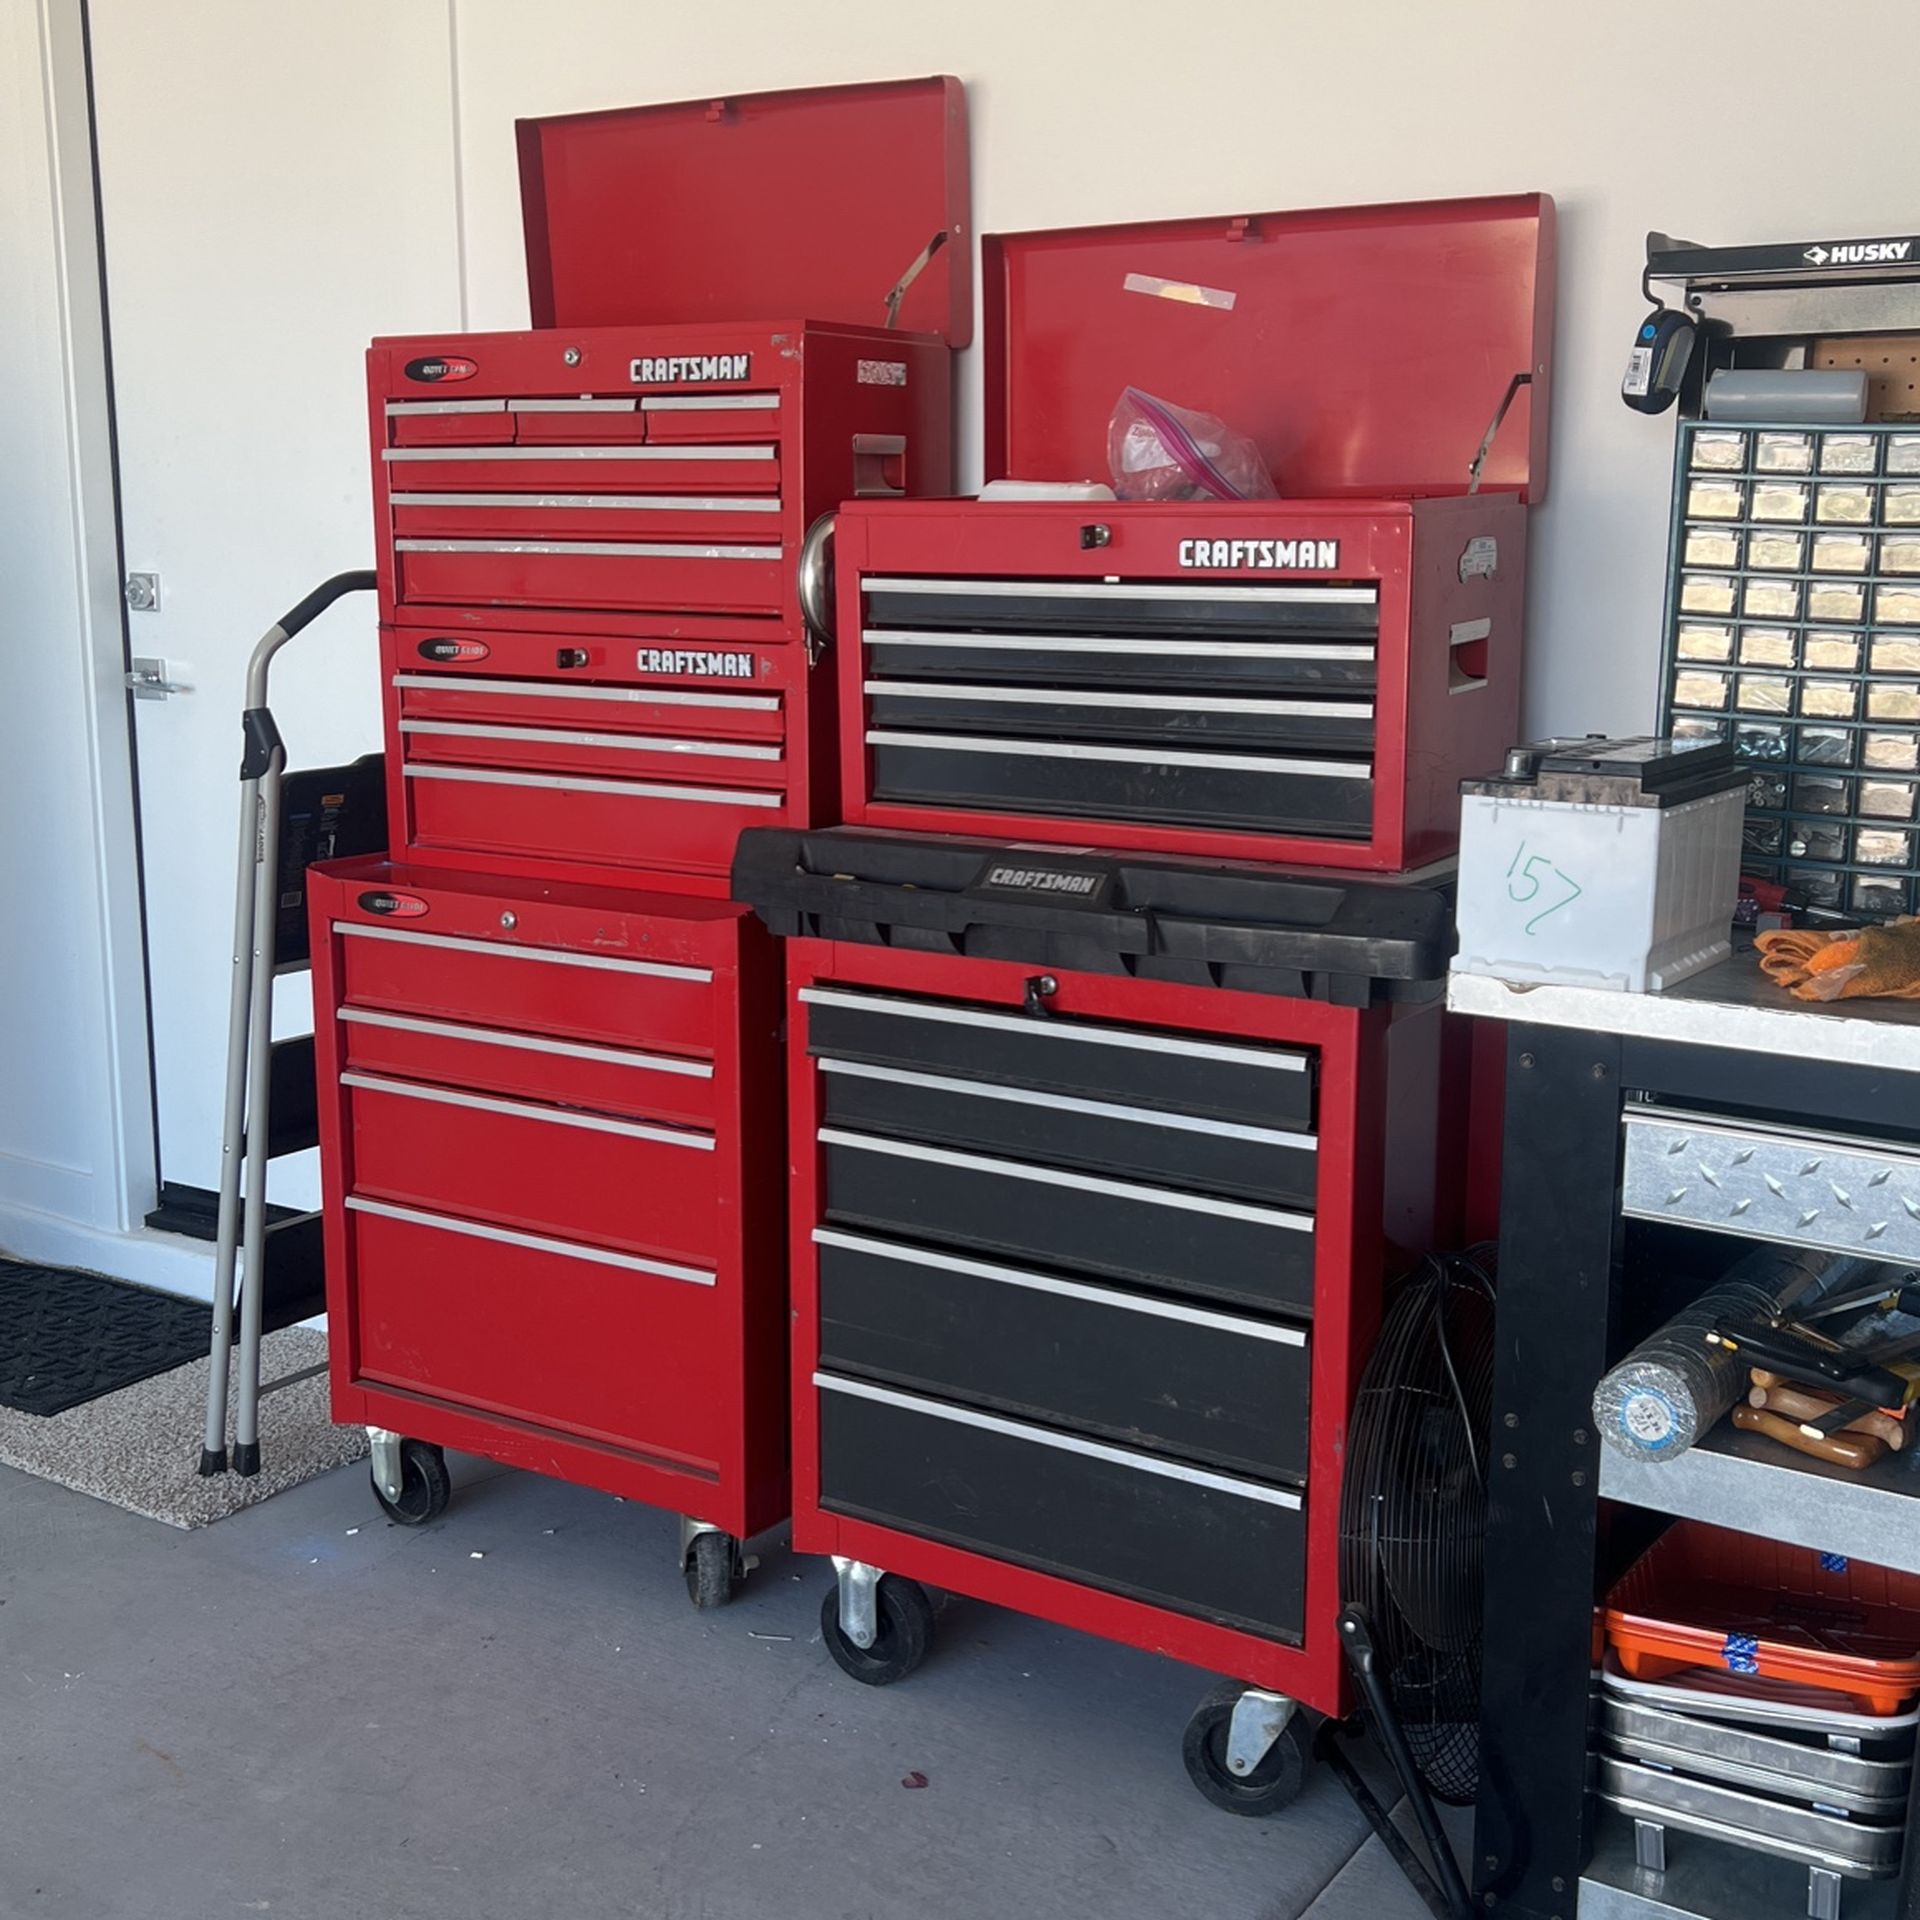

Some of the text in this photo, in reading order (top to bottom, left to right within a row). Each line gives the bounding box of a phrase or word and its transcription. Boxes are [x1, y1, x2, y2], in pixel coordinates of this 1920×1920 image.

[1831, 242, 1911, 263] HUSKY
[629, 355, 749, 382] CRAFTSMAN
[1179, 540, 1338, 569] CRAFTSMAN
[637, 649, 754, 677] CRAFTSMAN
[989, 867, 1096, 893] CRAFTSMAN
